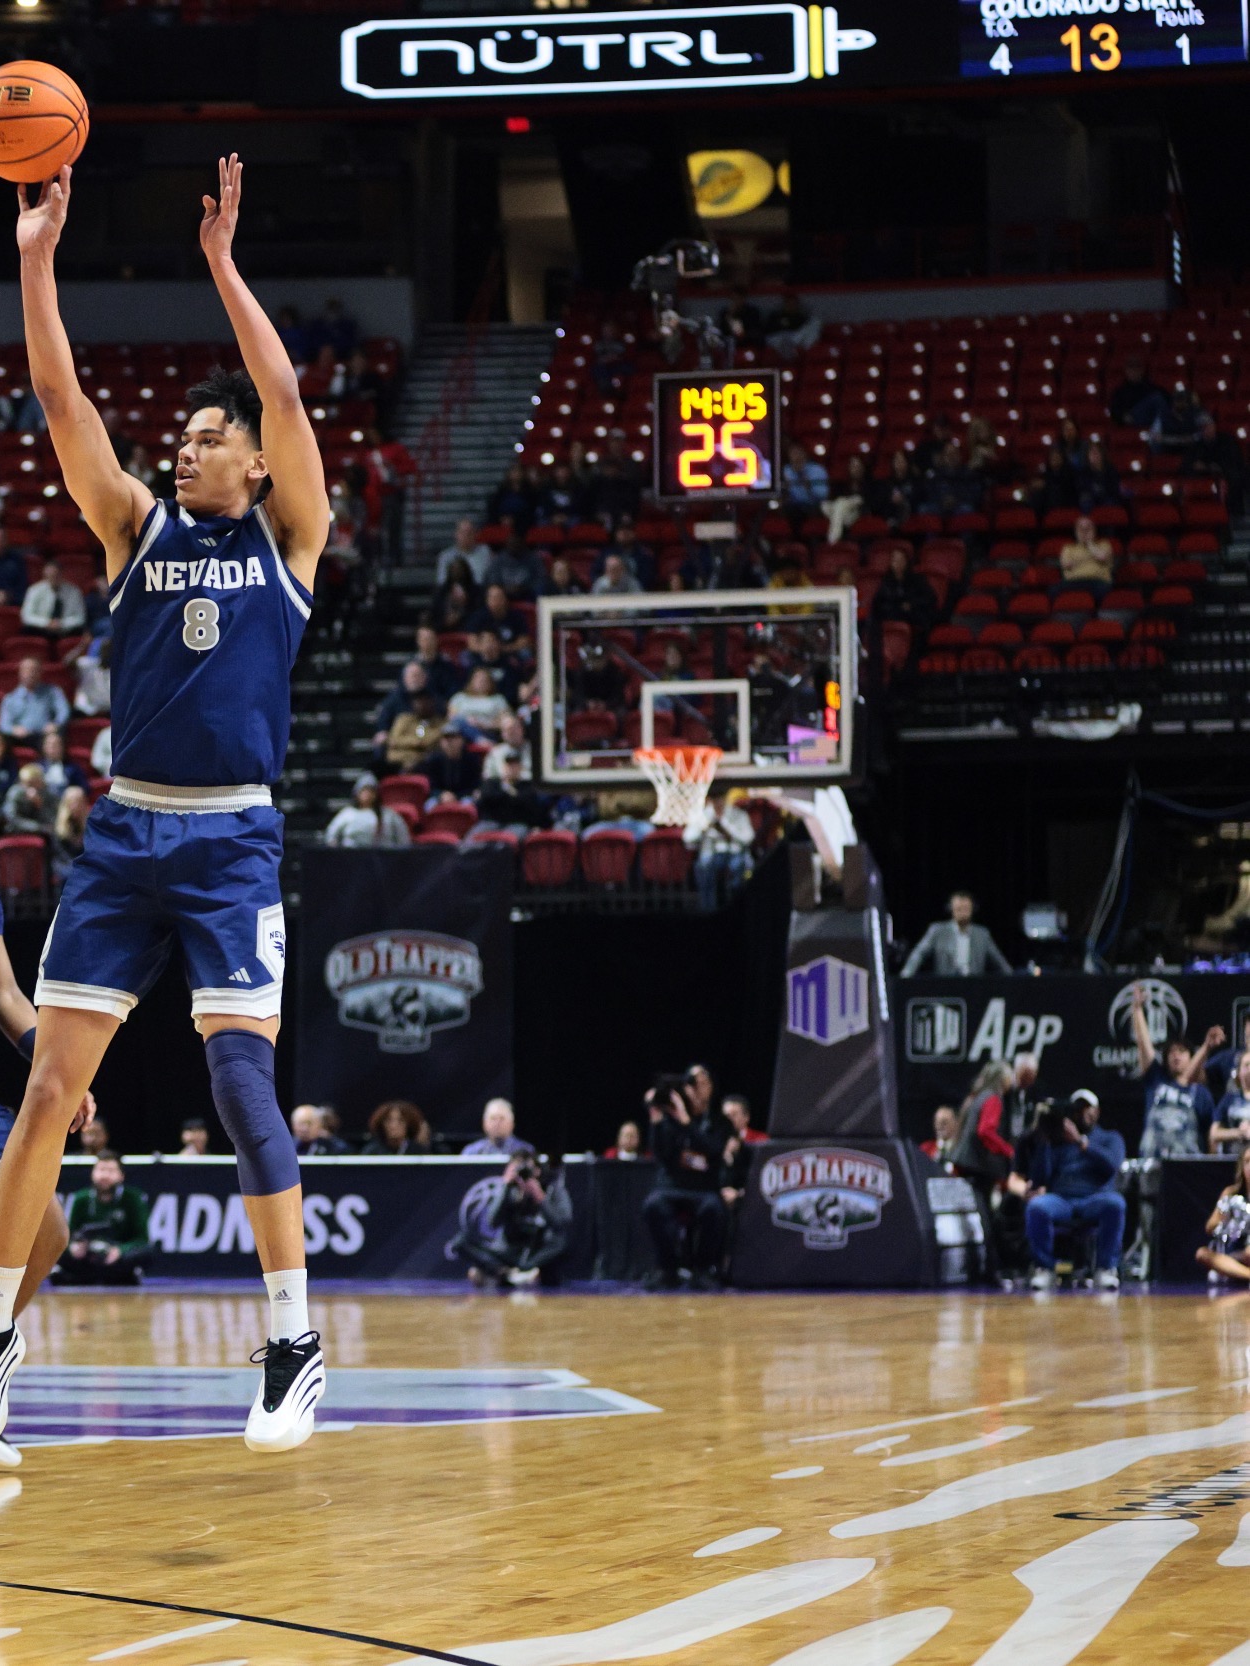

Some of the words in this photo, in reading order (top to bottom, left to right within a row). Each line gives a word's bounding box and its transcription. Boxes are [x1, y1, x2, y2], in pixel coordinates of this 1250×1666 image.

[989, 43, 1013, 76] 4
[1060, 23, 1122, 72] 13
[1175, 33, 1191, 66] 1
[680, 382, 768, 421] 14:05
[679, 421, 757, 488] 25
[143, 556, 267, 592] NEVADA
[182, 597, 220, 651] 8
[761, 1161, 803, 1197] OLD
[801, 1153, 893, 1200] TRAPPER
[140, 1193, 371, 1256] ADNSS
